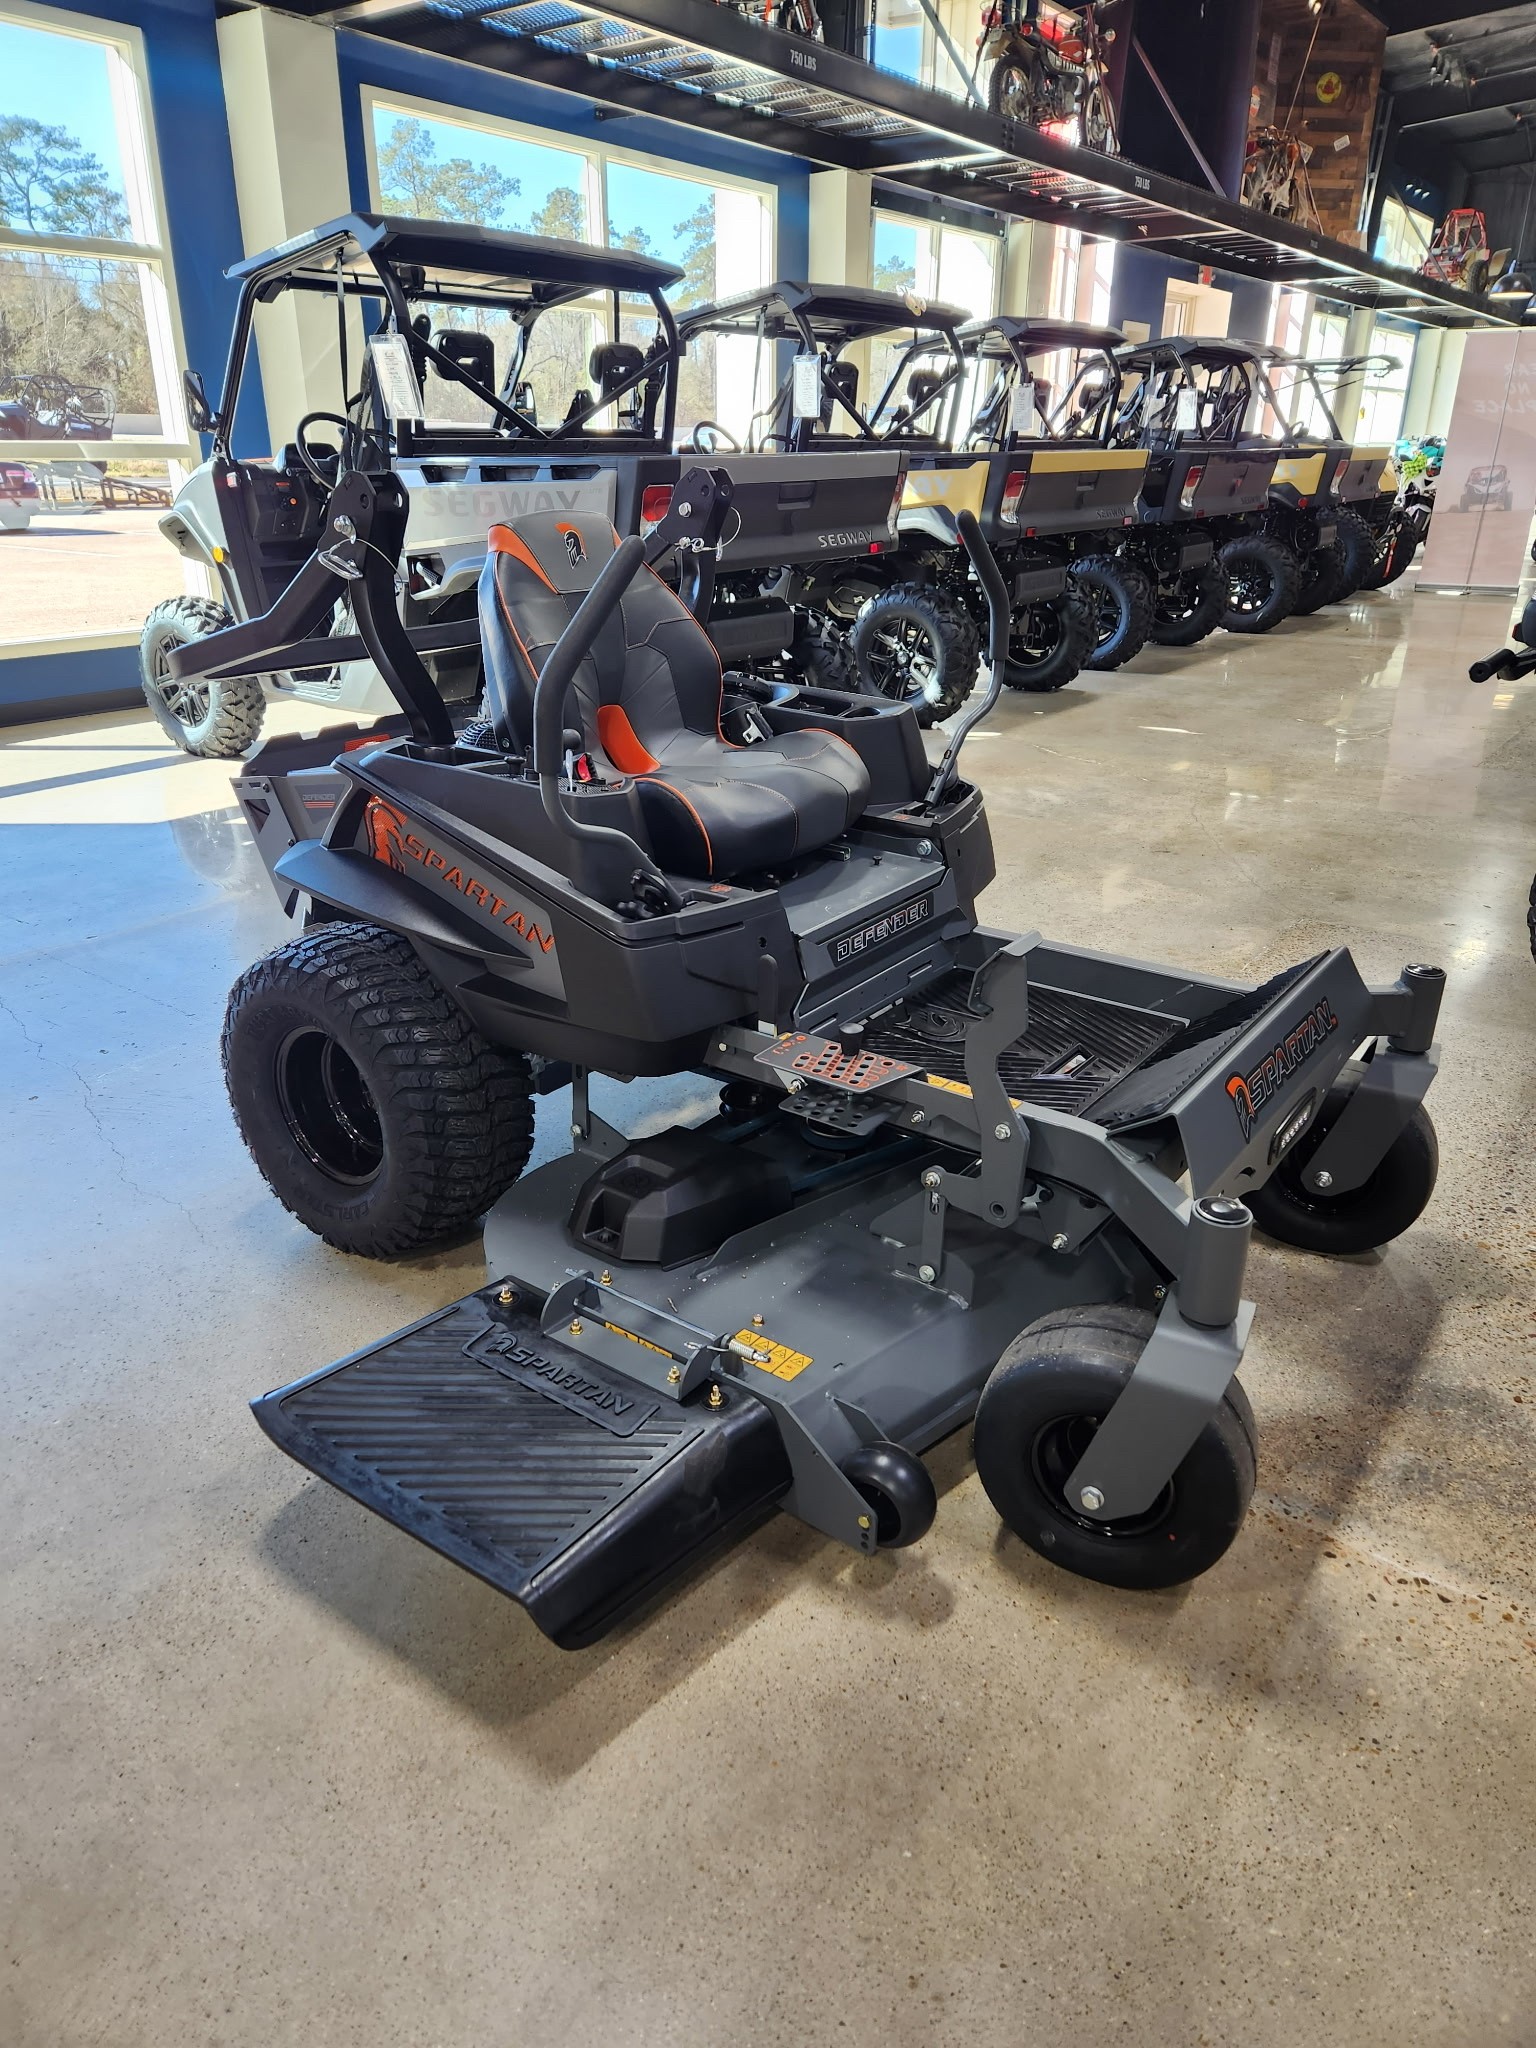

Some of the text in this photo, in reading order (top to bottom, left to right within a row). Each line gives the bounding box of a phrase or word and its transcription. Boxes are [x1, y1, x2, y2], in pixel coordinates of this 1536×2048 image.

[790, 49, 816, 71] 750 LBS
[1135, 175, 1150, 190] 750 LBS
[423, 489, 581, 518] SEGWAY
[818, 530, 873, 548] SEGWAY
[403, 834, 555, 954] SPARTAN
[837, 899, 929, 962] DEFENDER
[1246, 1000, 1333, 1111] SPARTAN
[505, 1346, 635, 1416] SPARTAN
